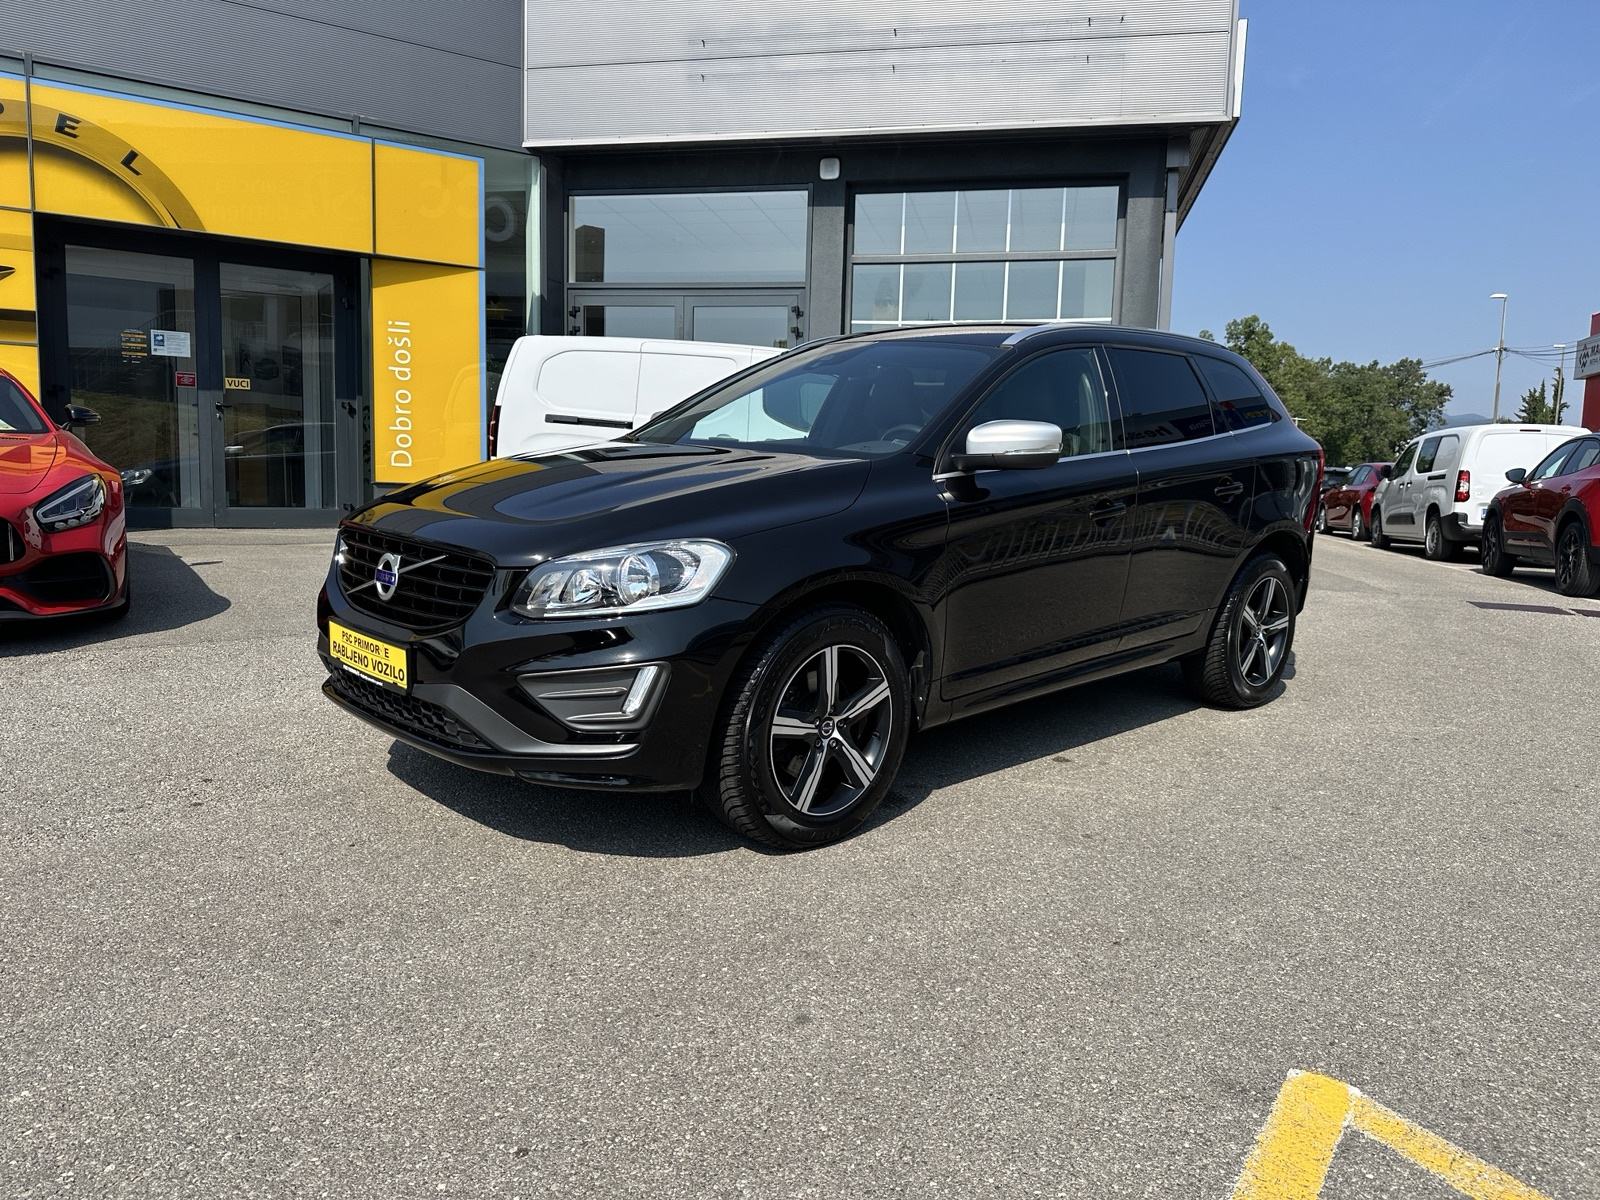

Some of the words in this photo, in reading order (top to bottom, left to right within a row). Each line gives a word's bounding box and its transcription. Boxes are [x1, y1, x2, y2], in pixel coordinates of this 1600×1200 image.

[387, 320, 412, 381] došli
[227, 379, 249, 389] VUCI
[389, 389, 413, 467] Dobro
[342, 630, 353, 644] PSC
[333, 640, 369, 668] RABLJENO
[371, 657, 405, 682] VOZILO
